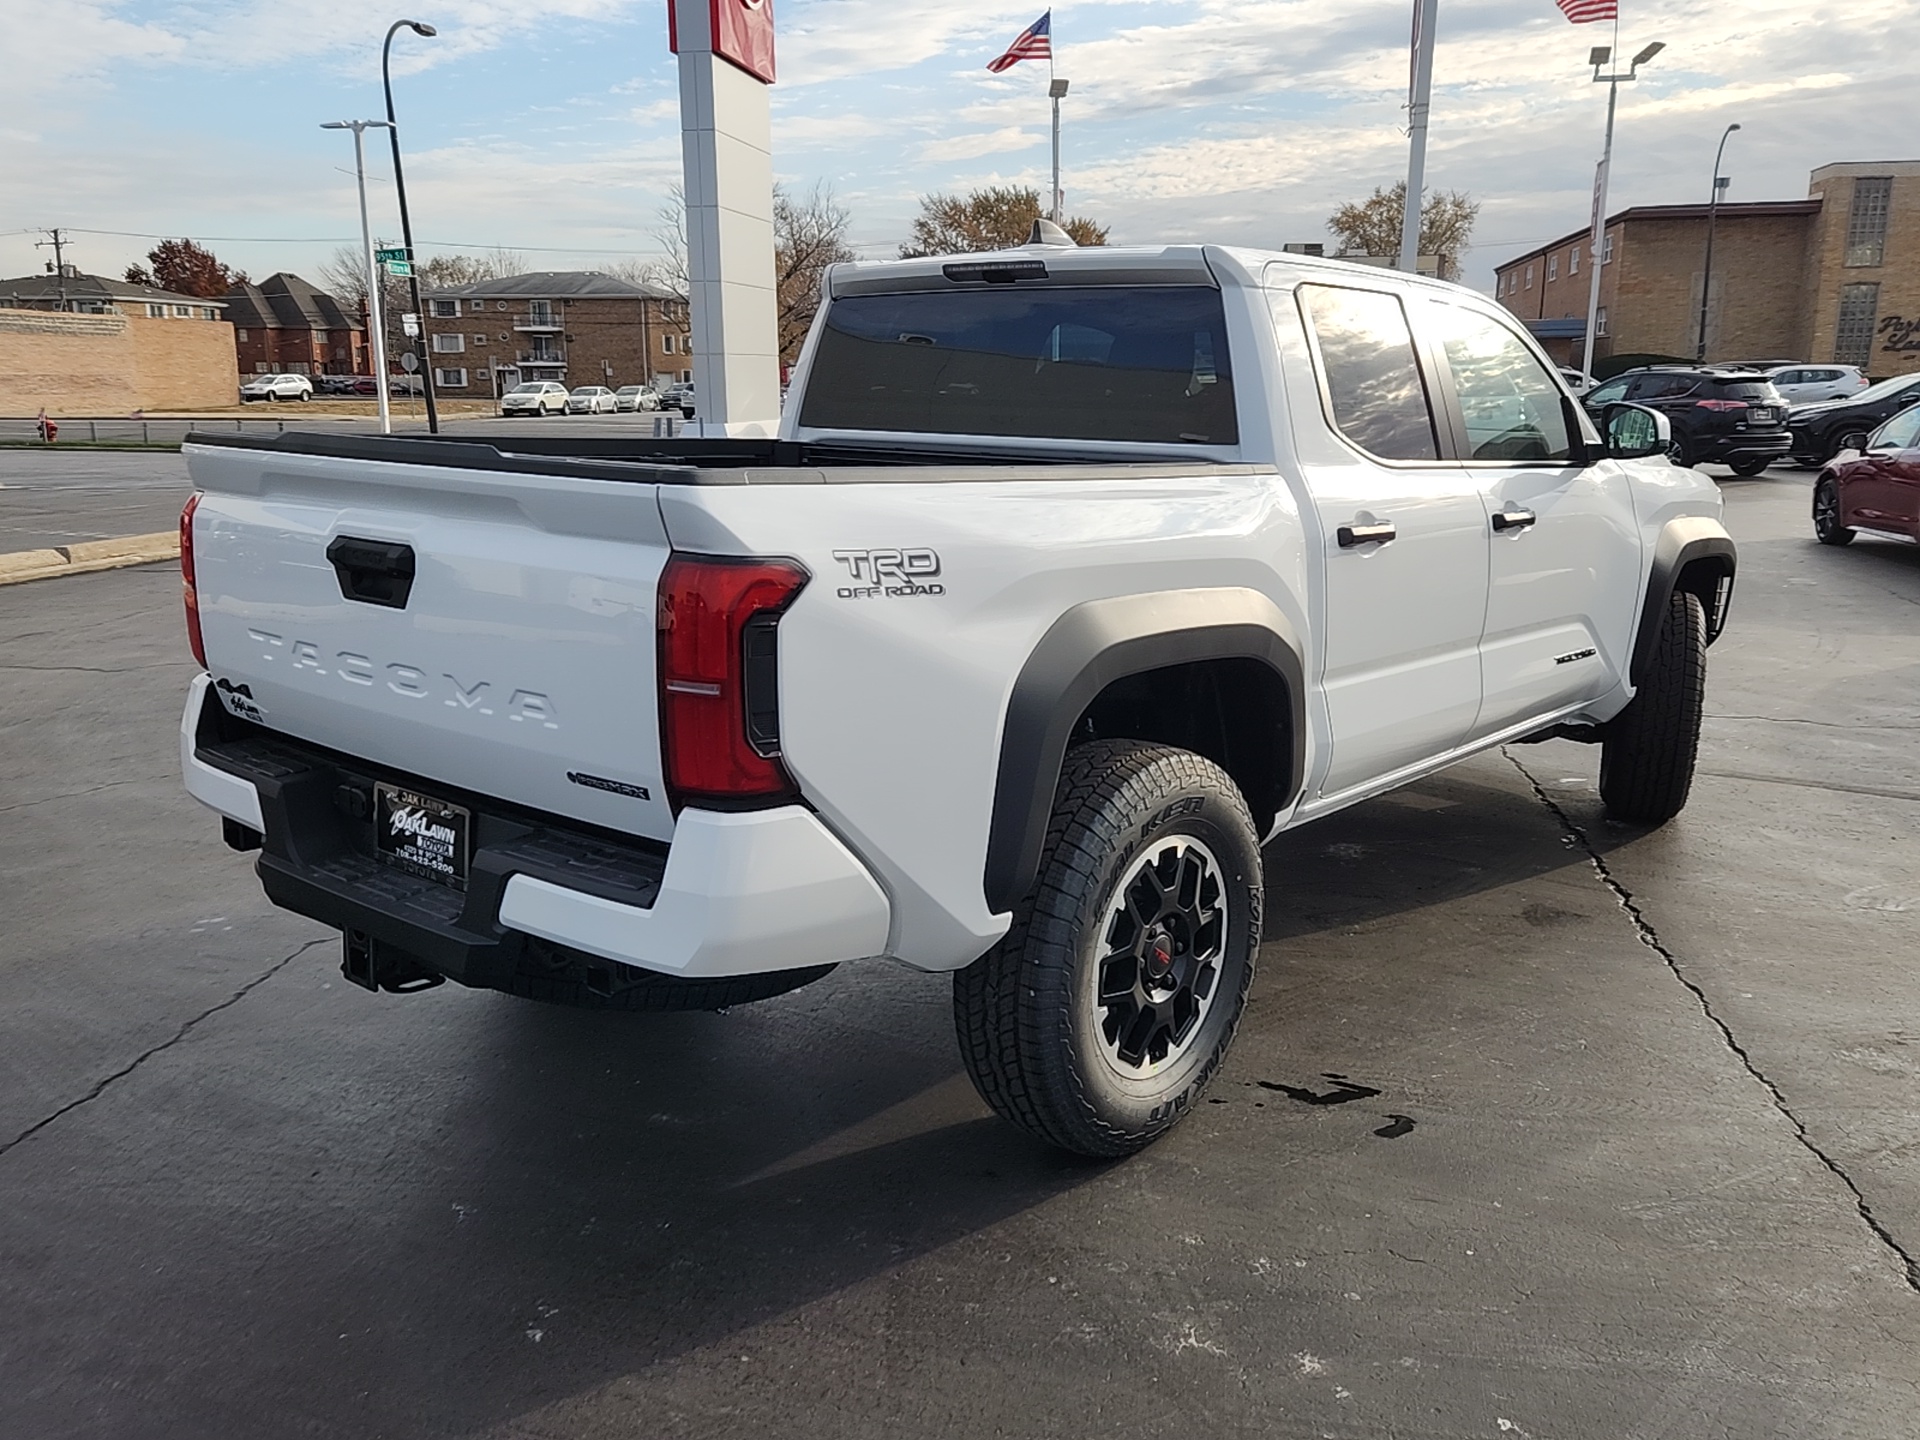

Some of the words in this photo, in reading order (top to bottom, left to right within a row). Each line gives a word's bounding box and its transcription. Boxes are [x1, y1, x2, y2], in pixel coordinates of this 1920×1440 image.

[376, 252, 393, 261] 95th
[832, 547, 941, 585] TRD
[837, 586, 881, 598] OFF
[885, 584, 945, 596] ROAD
[248, 628, 558, 729] TACOMA
[402, 792, 419, 805] OAK
[421, 798, 444, 811] LAWN
[420, 837, 450, 857] TOYOTA
[403, 861, 437, 880] TOYOTA
